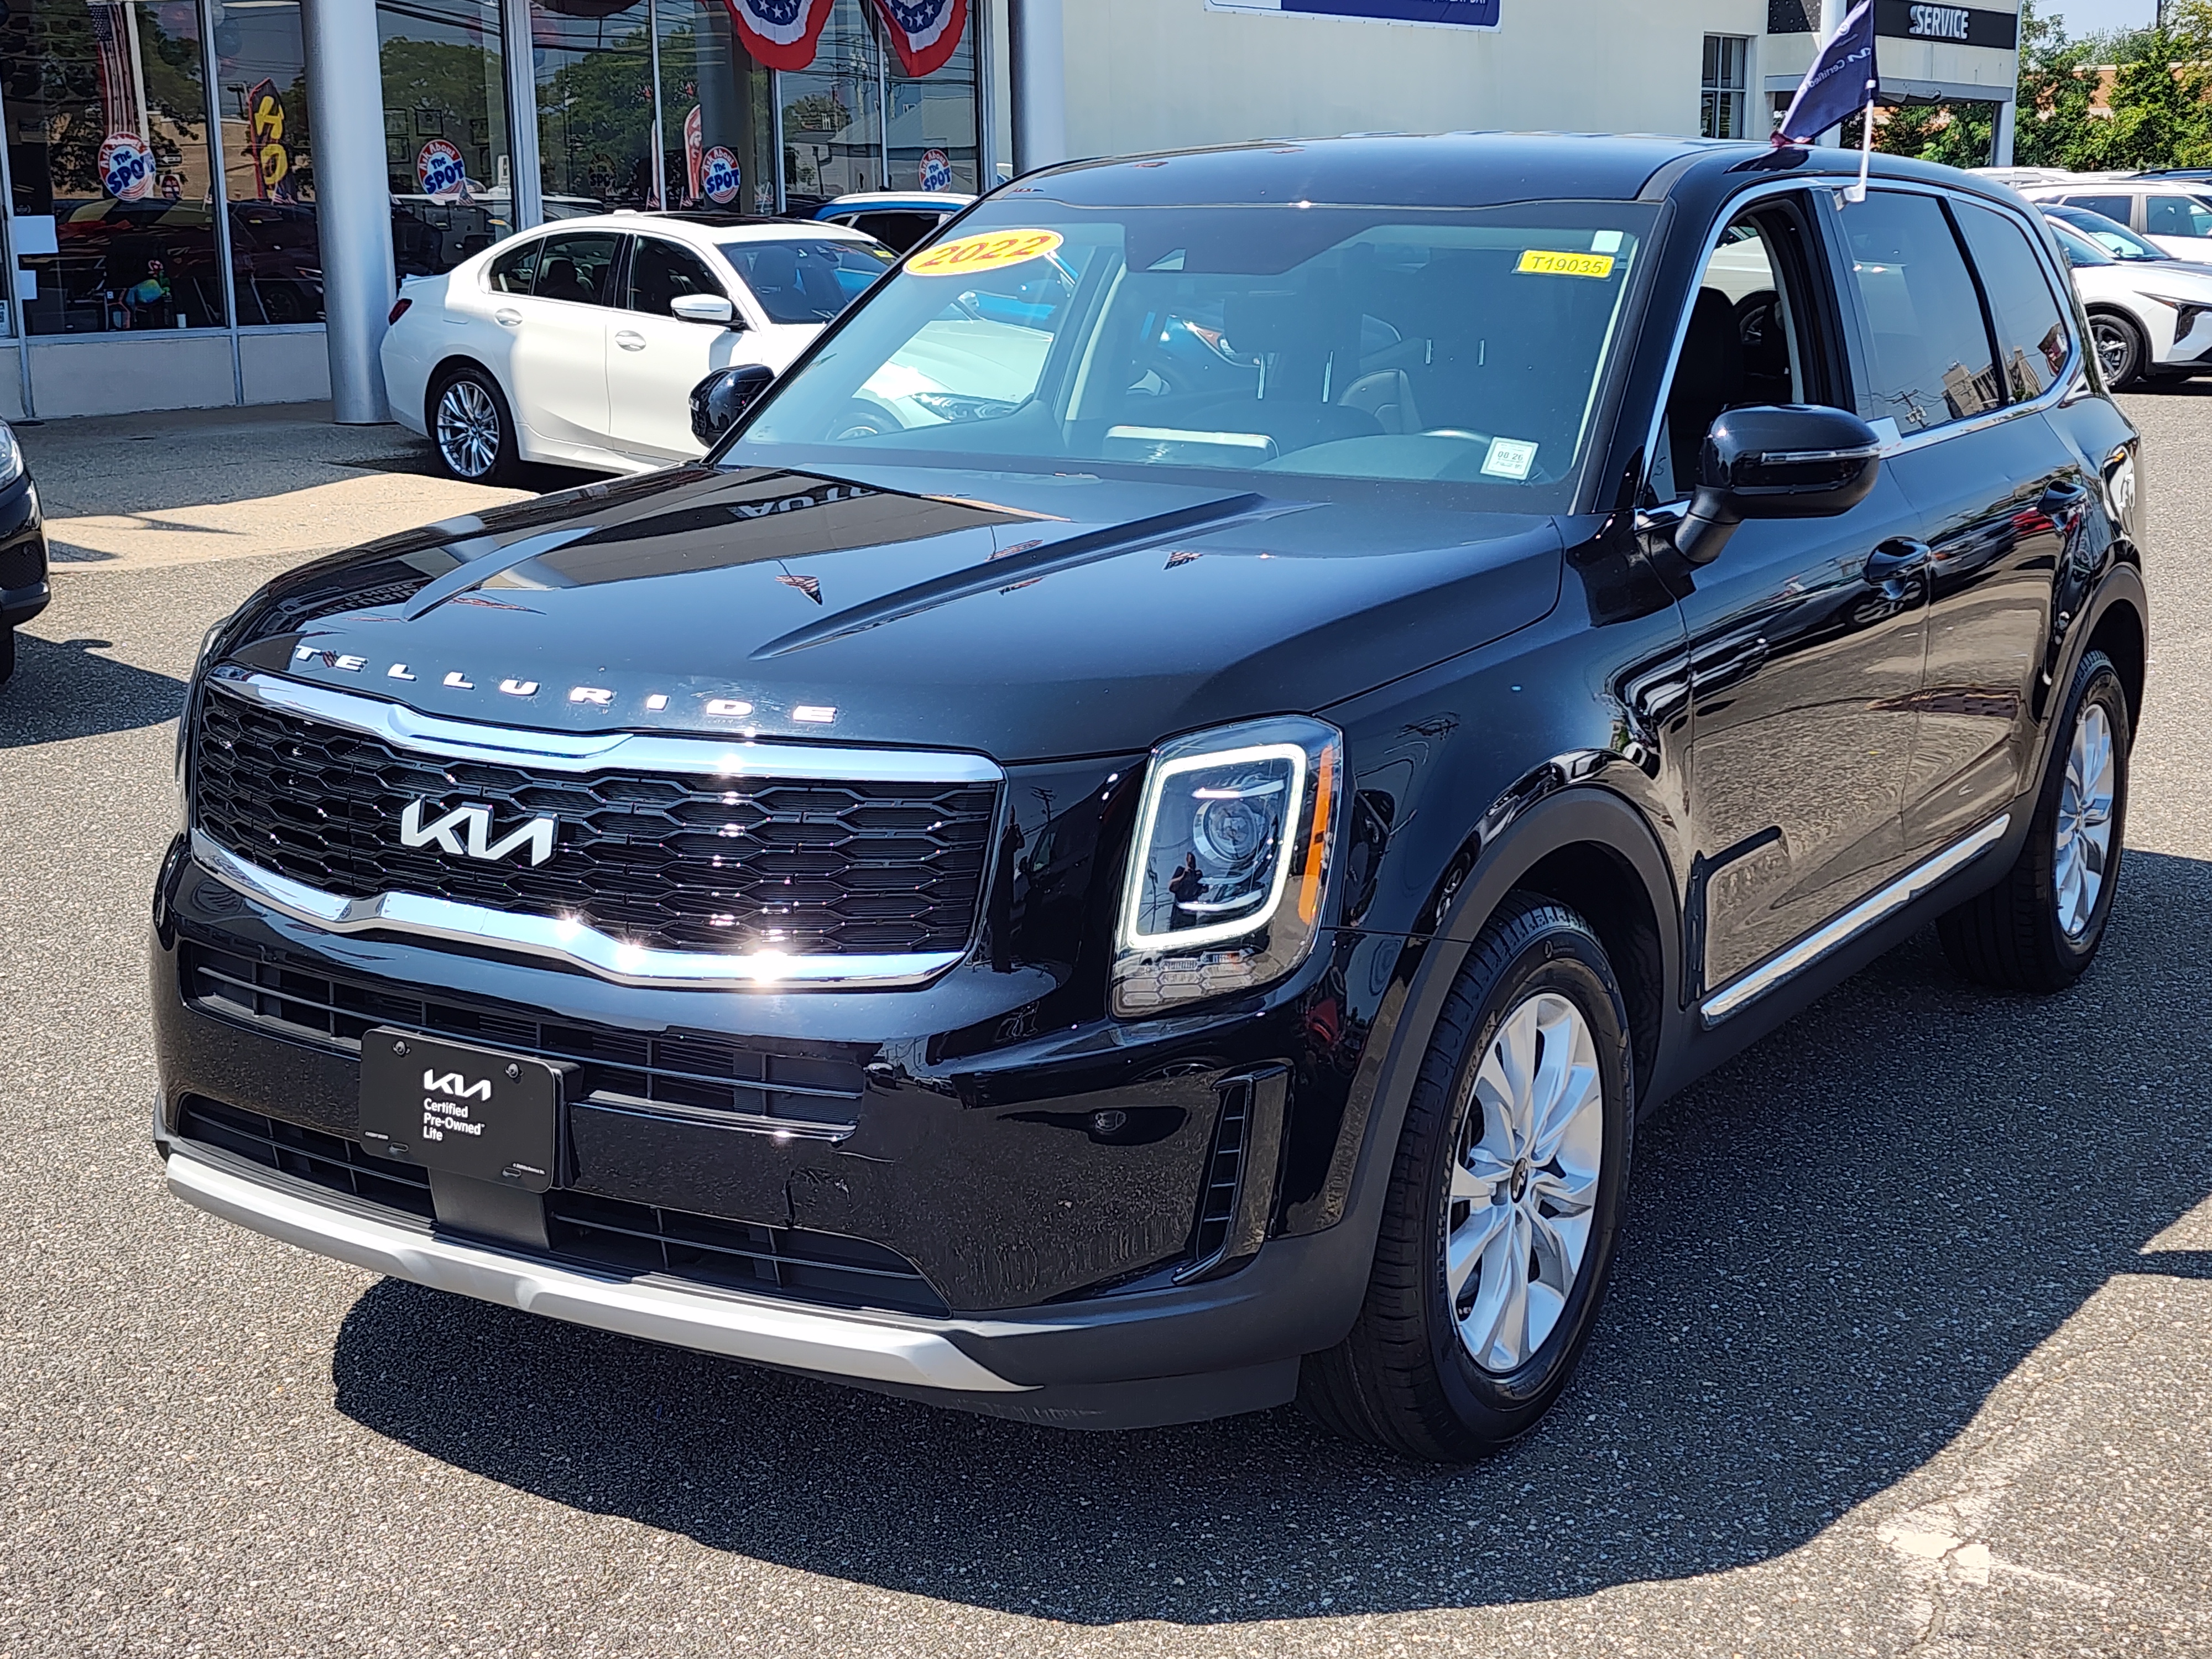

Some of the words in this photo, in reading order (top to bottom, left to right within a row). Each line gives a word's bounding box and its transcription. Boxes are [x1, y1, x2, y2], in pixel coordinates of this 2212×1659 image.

[1910, 5, 1969, 39] SERVICE
[112, 150, 132, 166] The
[419, 152, 432, 171] Ask
[429, 142, 456, 158] About
[431, 156, 447, 170] The
[713, 163, 726, 173] The
[424, 160, 465, 195] SPOT
[706, 169, 740, 195] SPOT
[924, 167, 951, 192] SPOT
[915, 236, 1051, 269] 2022
[1532, 256, 1604, 274] T19035
[295, 644, 838, 724] TELLURIDE
[400, 798, 555, 867] KIA
[424, 1068, 491, 1101] KIA
[424, 1098, 468, 1118] Certified
[423, 1125, 443, 1141] Lite
